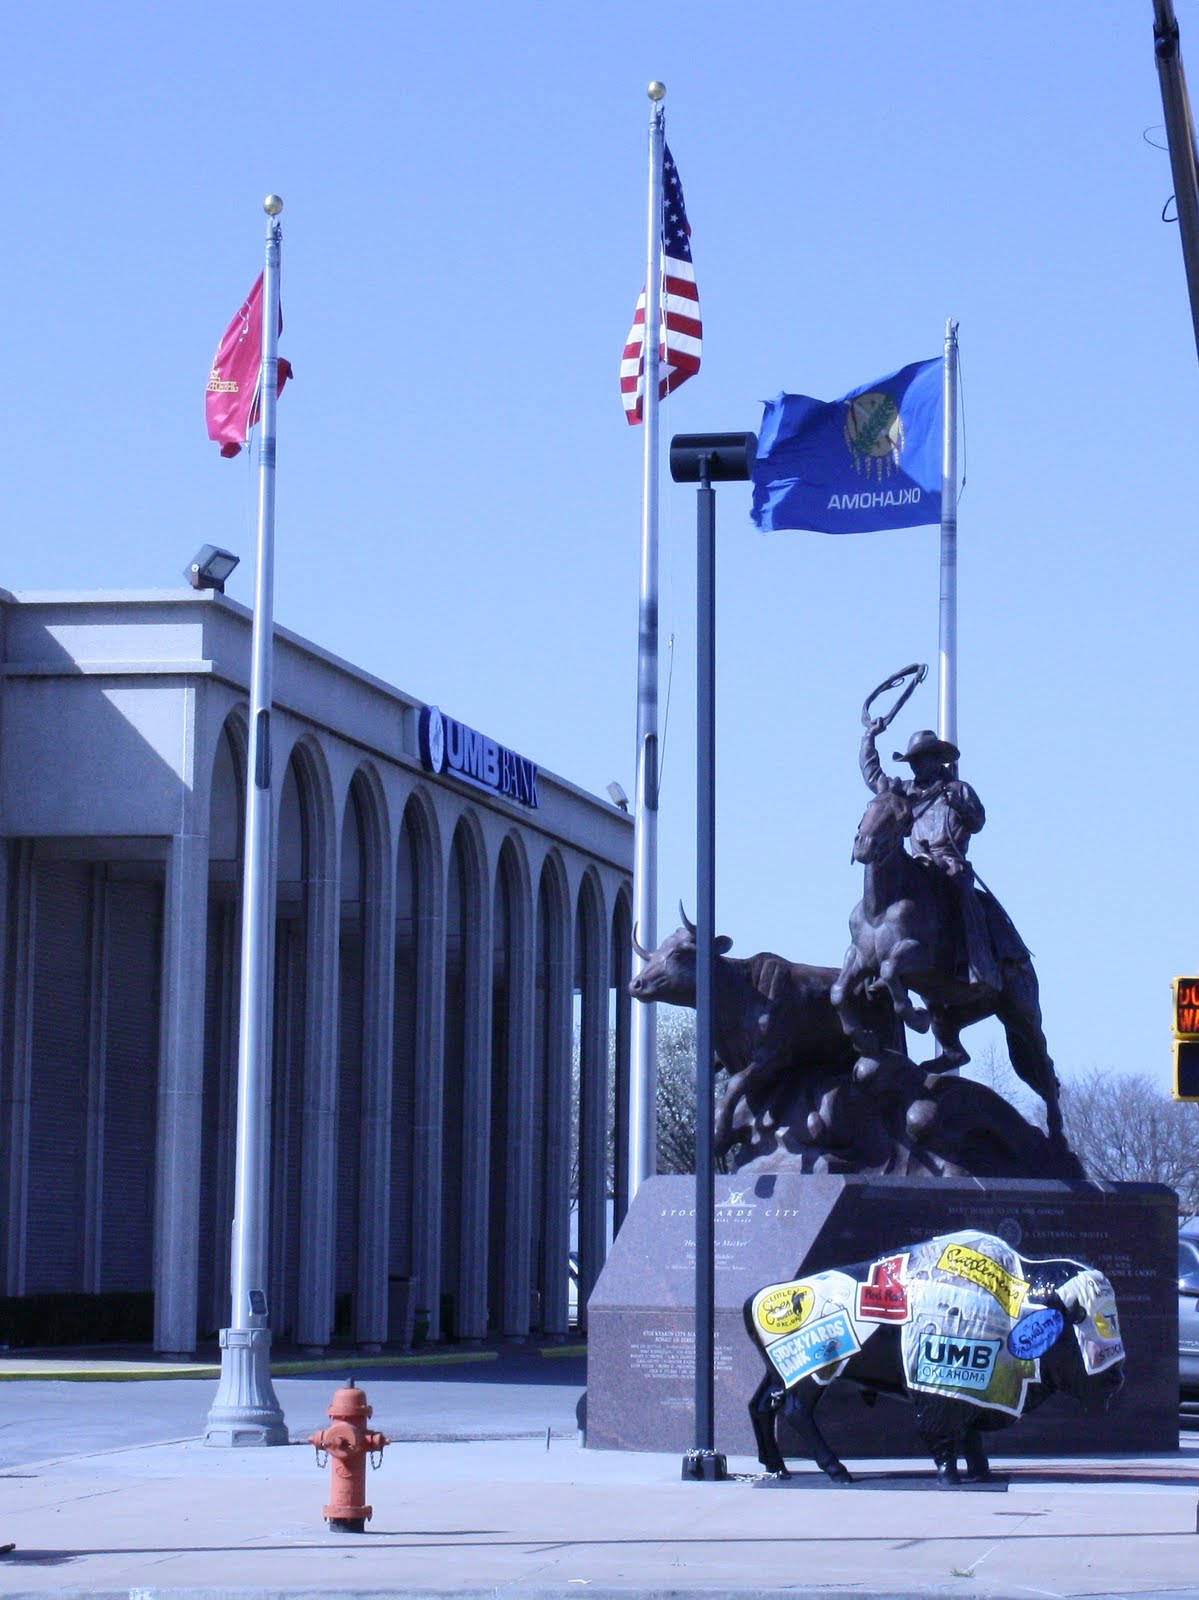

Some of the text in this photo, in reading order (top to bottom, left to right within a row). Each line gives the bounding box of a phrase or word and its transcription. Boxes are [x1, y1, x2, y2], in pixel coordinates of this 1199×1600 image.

[446, 719, 539, 809] UMB BANK
[661, 1209, 799, 1217] STOCARDS CITY
[772, 1320, 845, 1360] STOCKYARDS
[778, 1350, 811, 1377] BANK
[924, 1341, 991, 1370] UMB
[922, 1366, 985, 1383] OKLAHOMA
